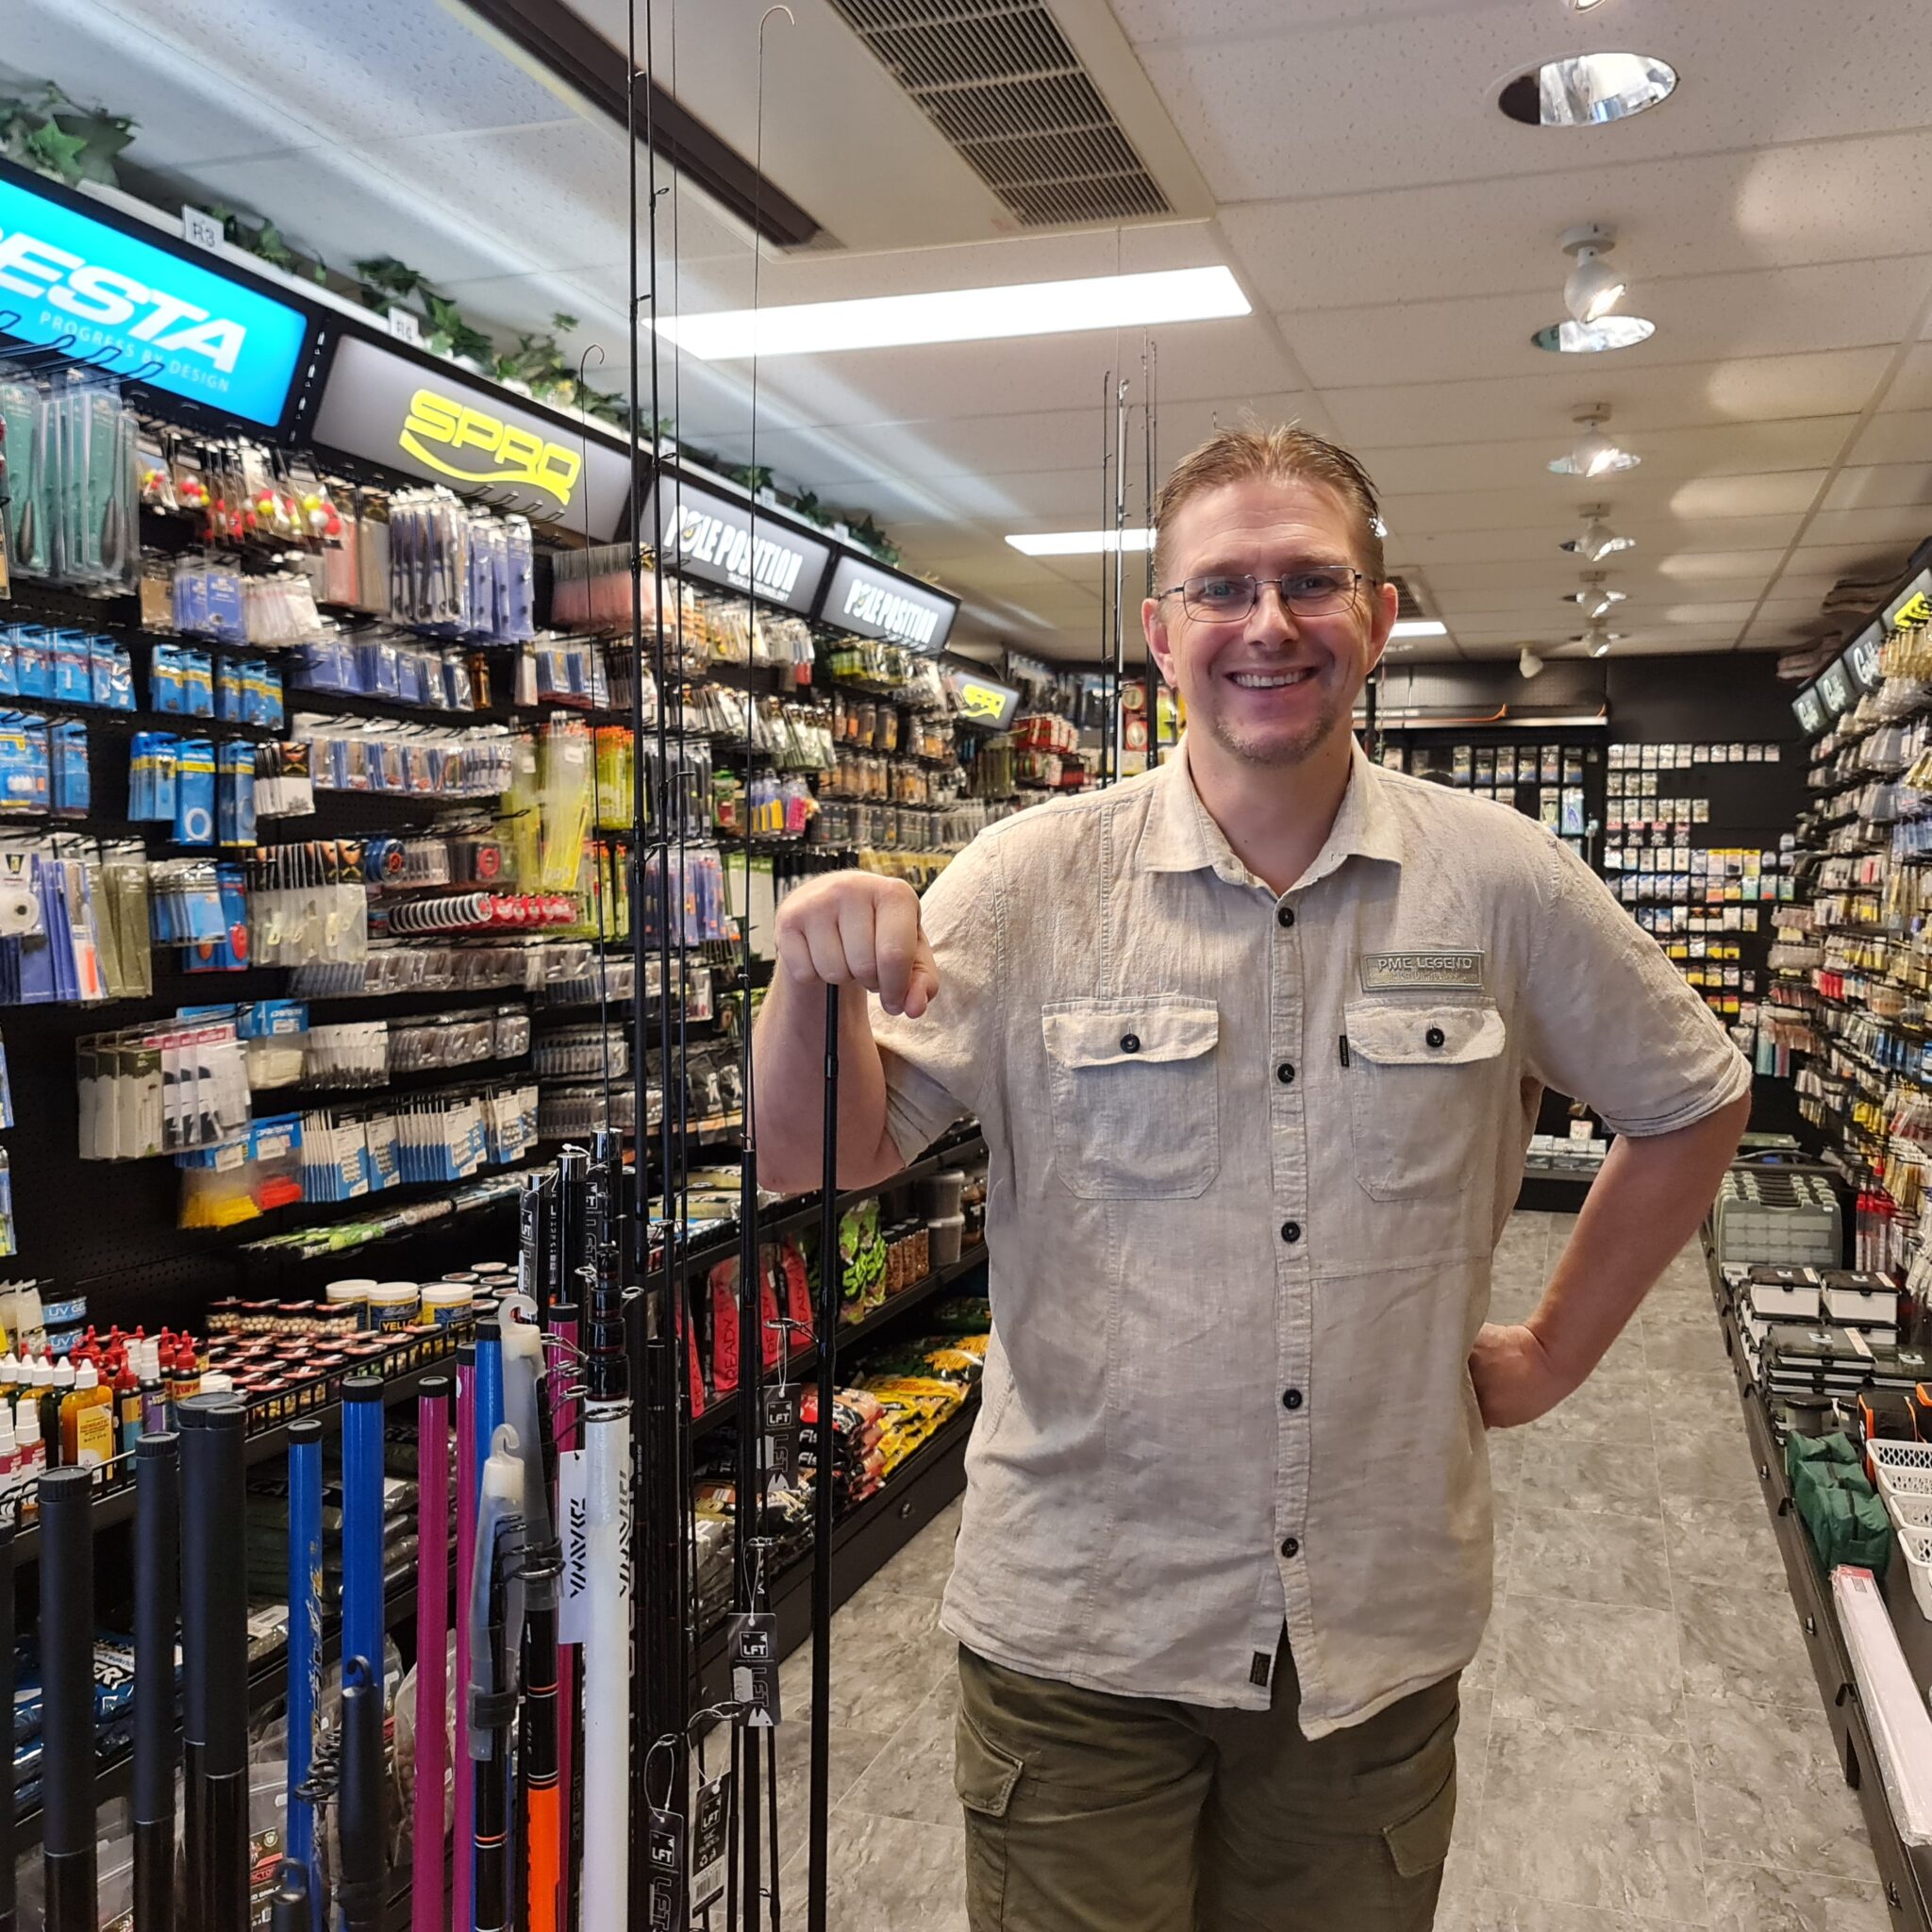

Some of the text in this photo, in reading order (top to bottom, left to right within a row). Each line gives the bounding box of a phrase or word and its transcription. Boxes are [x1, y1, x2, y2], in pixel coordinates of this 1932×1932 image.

[192, 222, 215, 248] R3
[0, 226, 247, 374] ESTA
[40, 310, 230, 392] PROGRESS BY DESIGN
[403, 389, 581, 492] SPRO
[663, 504, 803, 592] POLE POSITION
[876, 592, 939, 643] POSITION
[1377, 957, 1473, 972] PME LEGEND
[49, 1307, 69, 1317] UV
[51, 1336, 70, 1347] UV
[769, 1412, 790, 1424] LFT
[570, 1498, 586, 1598] DAIWA
[742, 1644, 767, 1657] LFT
[703, 1810, 720, 1829] LFT
[652, 1846, 673, 1864] LFT
